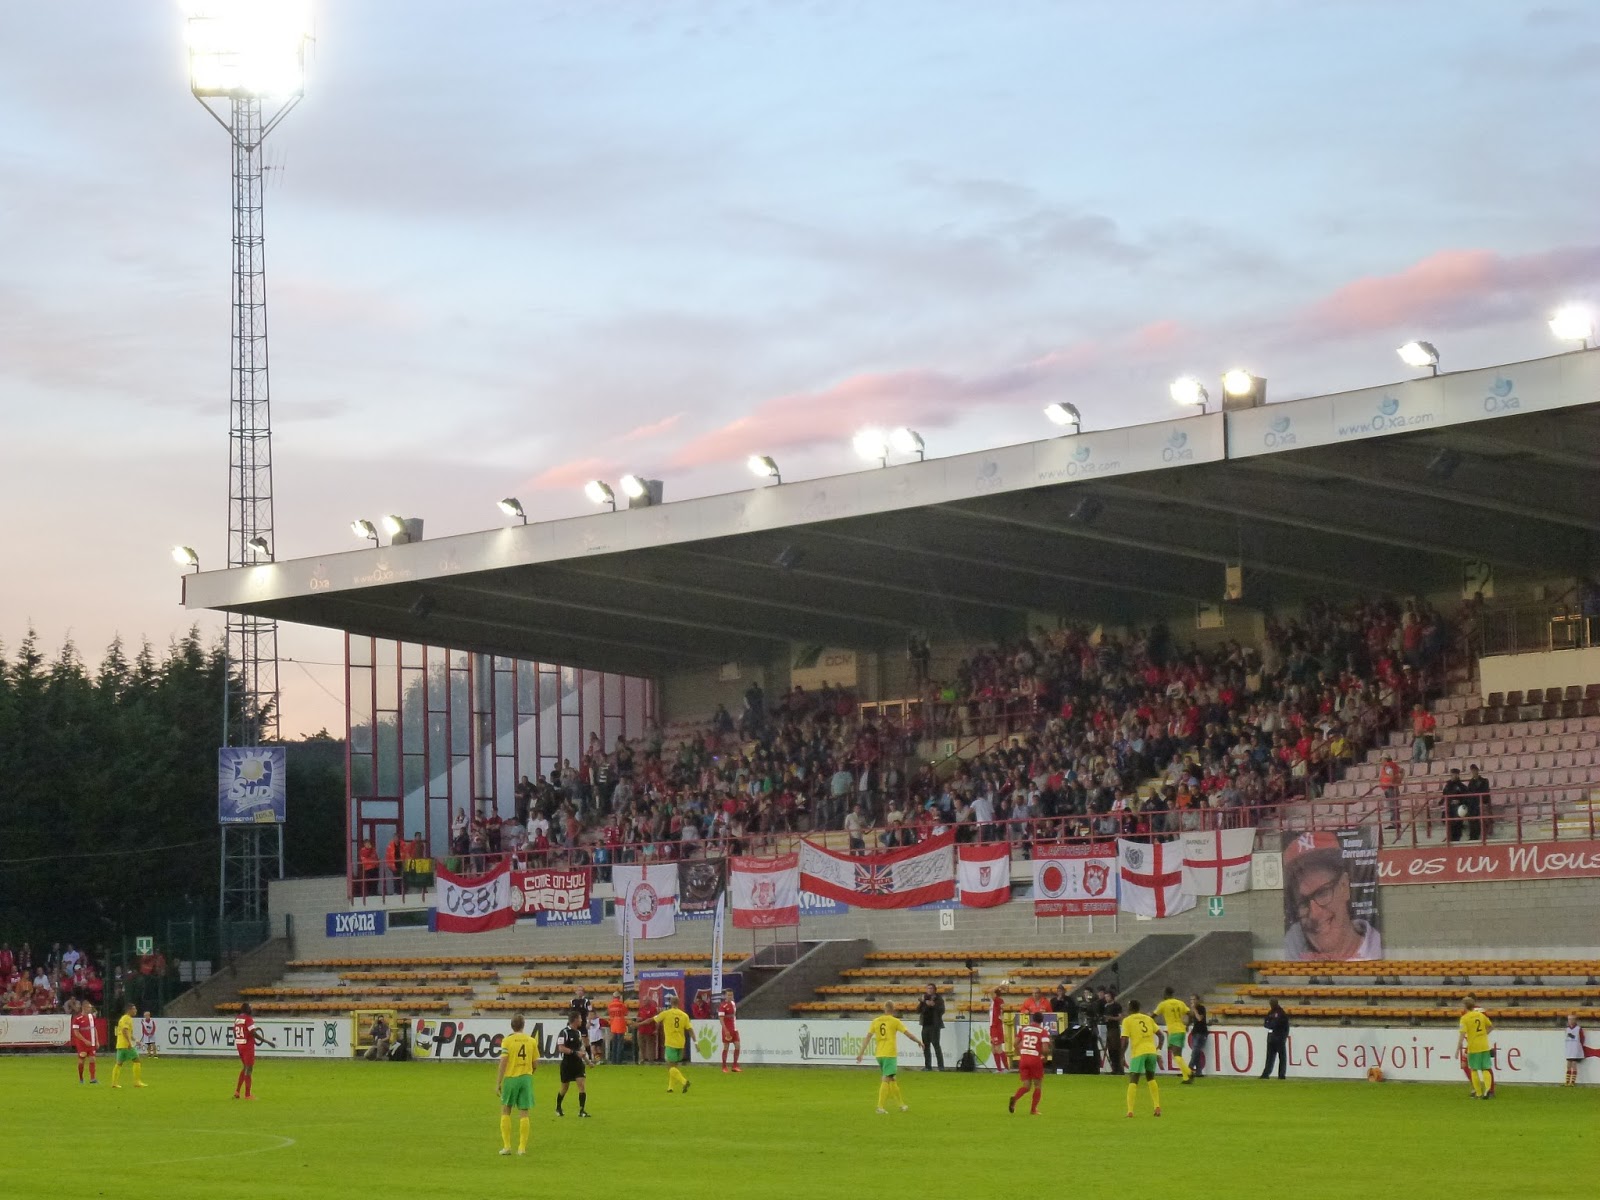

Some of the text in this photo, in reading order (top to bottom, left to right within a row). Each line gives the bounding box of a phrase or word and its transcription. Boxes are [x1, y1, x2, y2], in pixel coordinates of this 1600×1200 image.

[1377, 860, 1401, 877] u
[1408, 856, 1447, 876] es
[1457, 854, 1499, 873] un
[524, 872, 586, 890] COME ON YOU
[524, 888, 585, 912] REDS
[941, 912, 953, 926] C1
[674, 1017, 680, 1028] 8
[879, 1022, 886, 1036] 6
[1139, 1020, 1148, 1033] 3
[1475, 1018, 1482, 1032] 2
[168, 1026, 265, 1046] GROWEO
[235, 1026, 245, 1039] 24
[433, 1021, 564, 1059] Piece Au
[1023, 1034, 1038, 1049] 22
[518, 1043, 526, 1060] 4
[1287, 1035, 1319, 1067] Le
